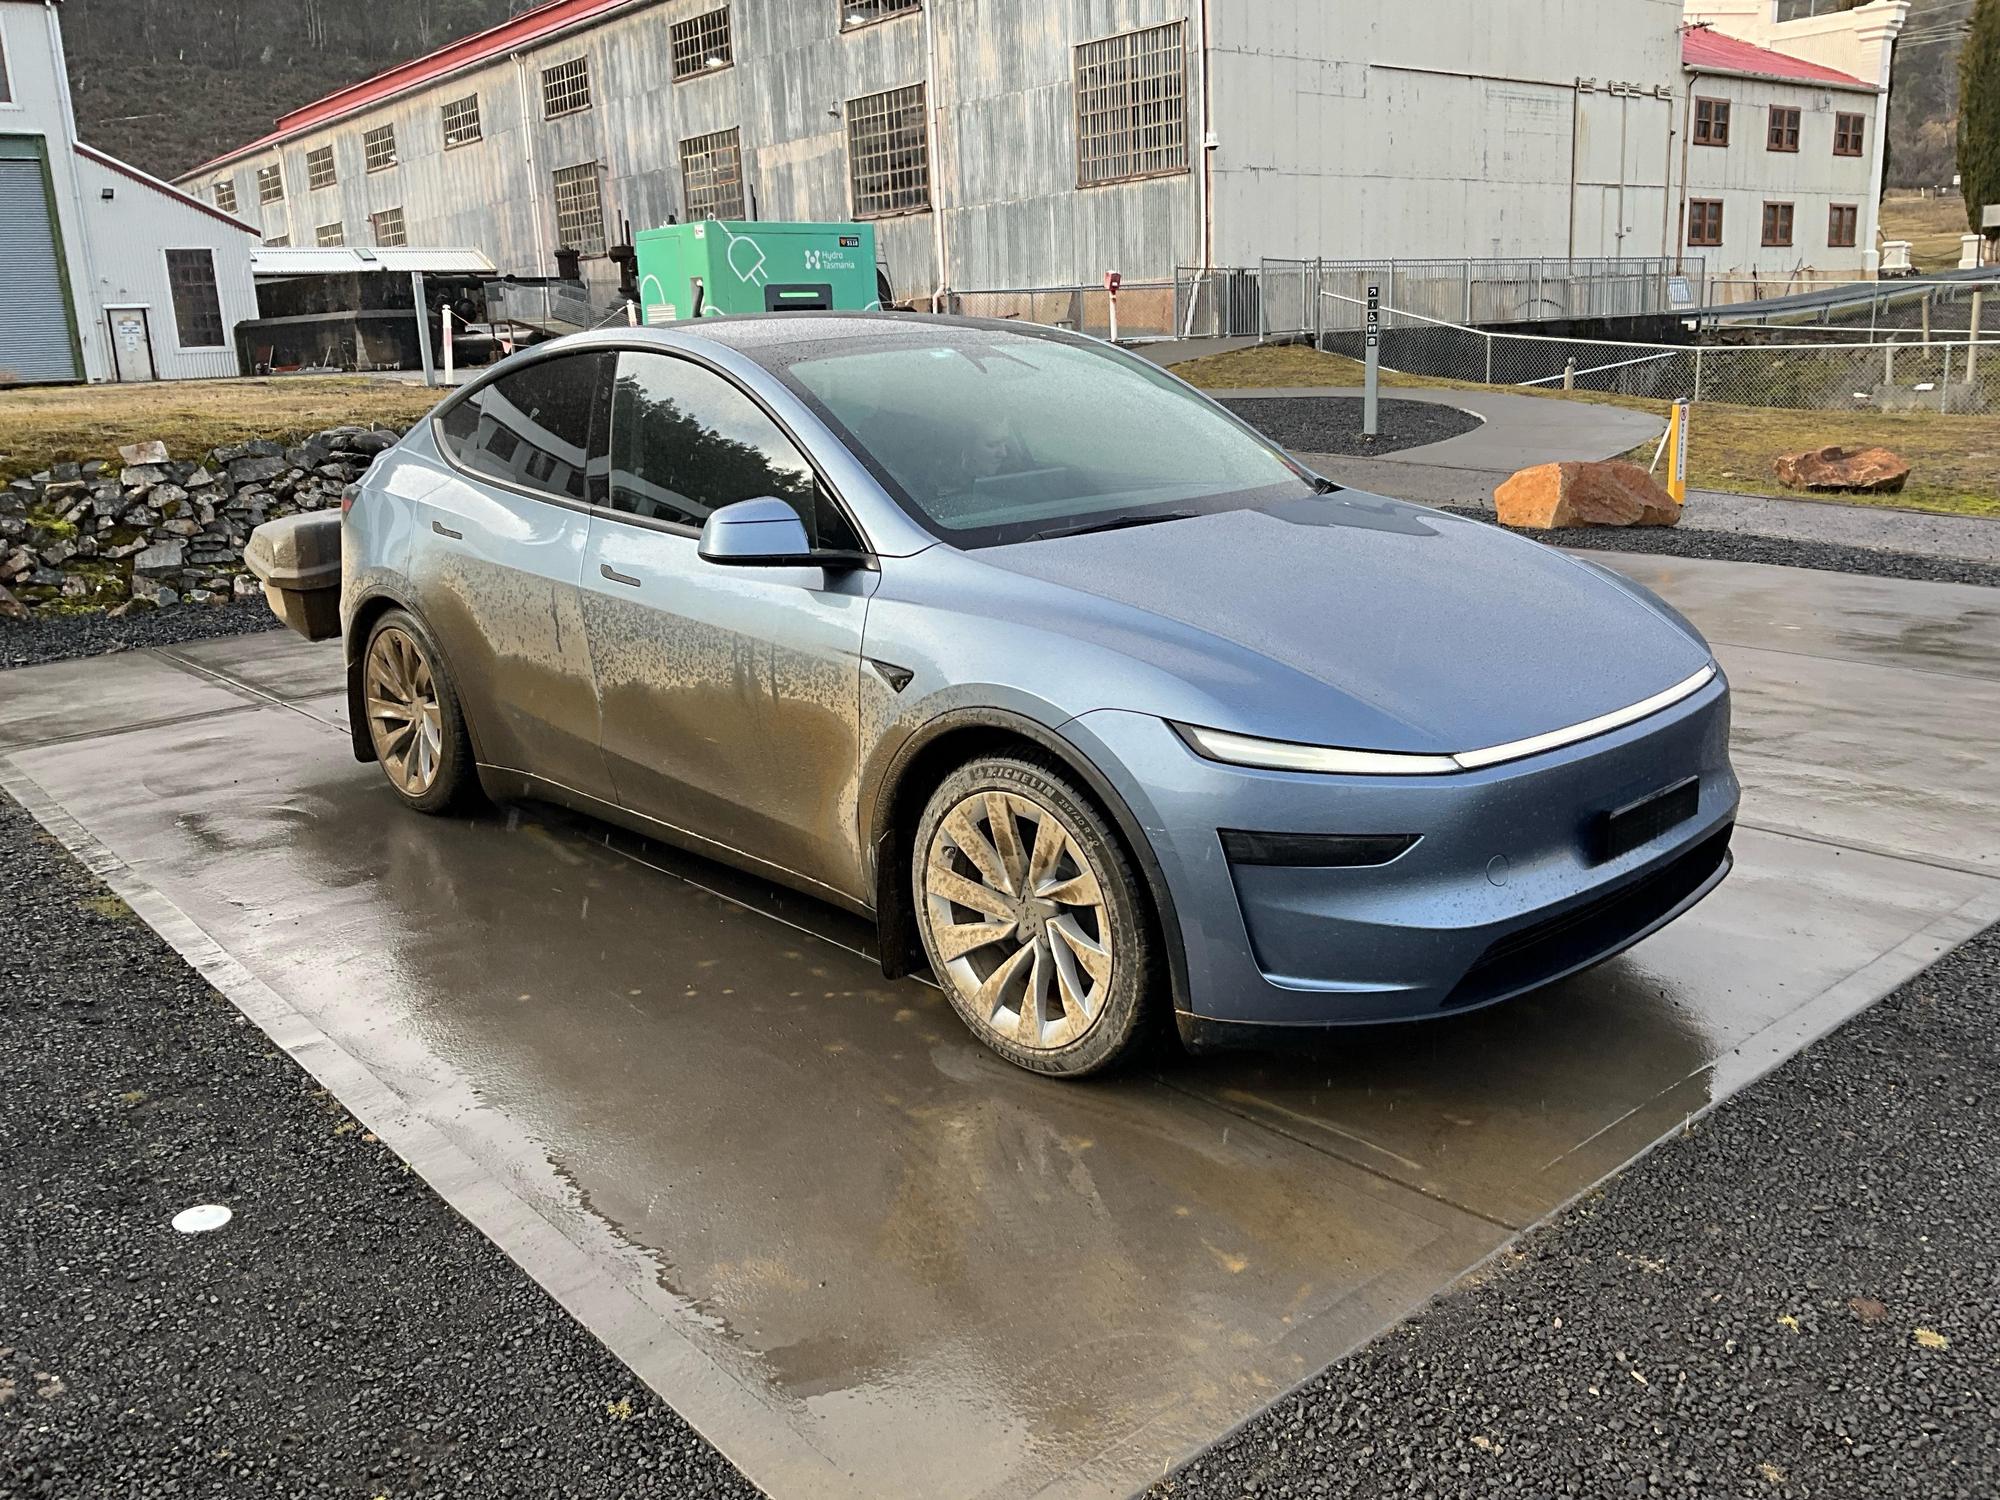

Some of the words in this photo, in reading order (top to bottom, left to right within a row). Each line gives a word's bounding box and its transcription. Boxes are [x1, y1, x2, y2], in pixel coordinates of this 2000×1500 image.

[822, 251, 844, 261] Hydro
[823, 261, 855, 269] Tasmania
[986, 767, 1056, 797] MICHELIN
